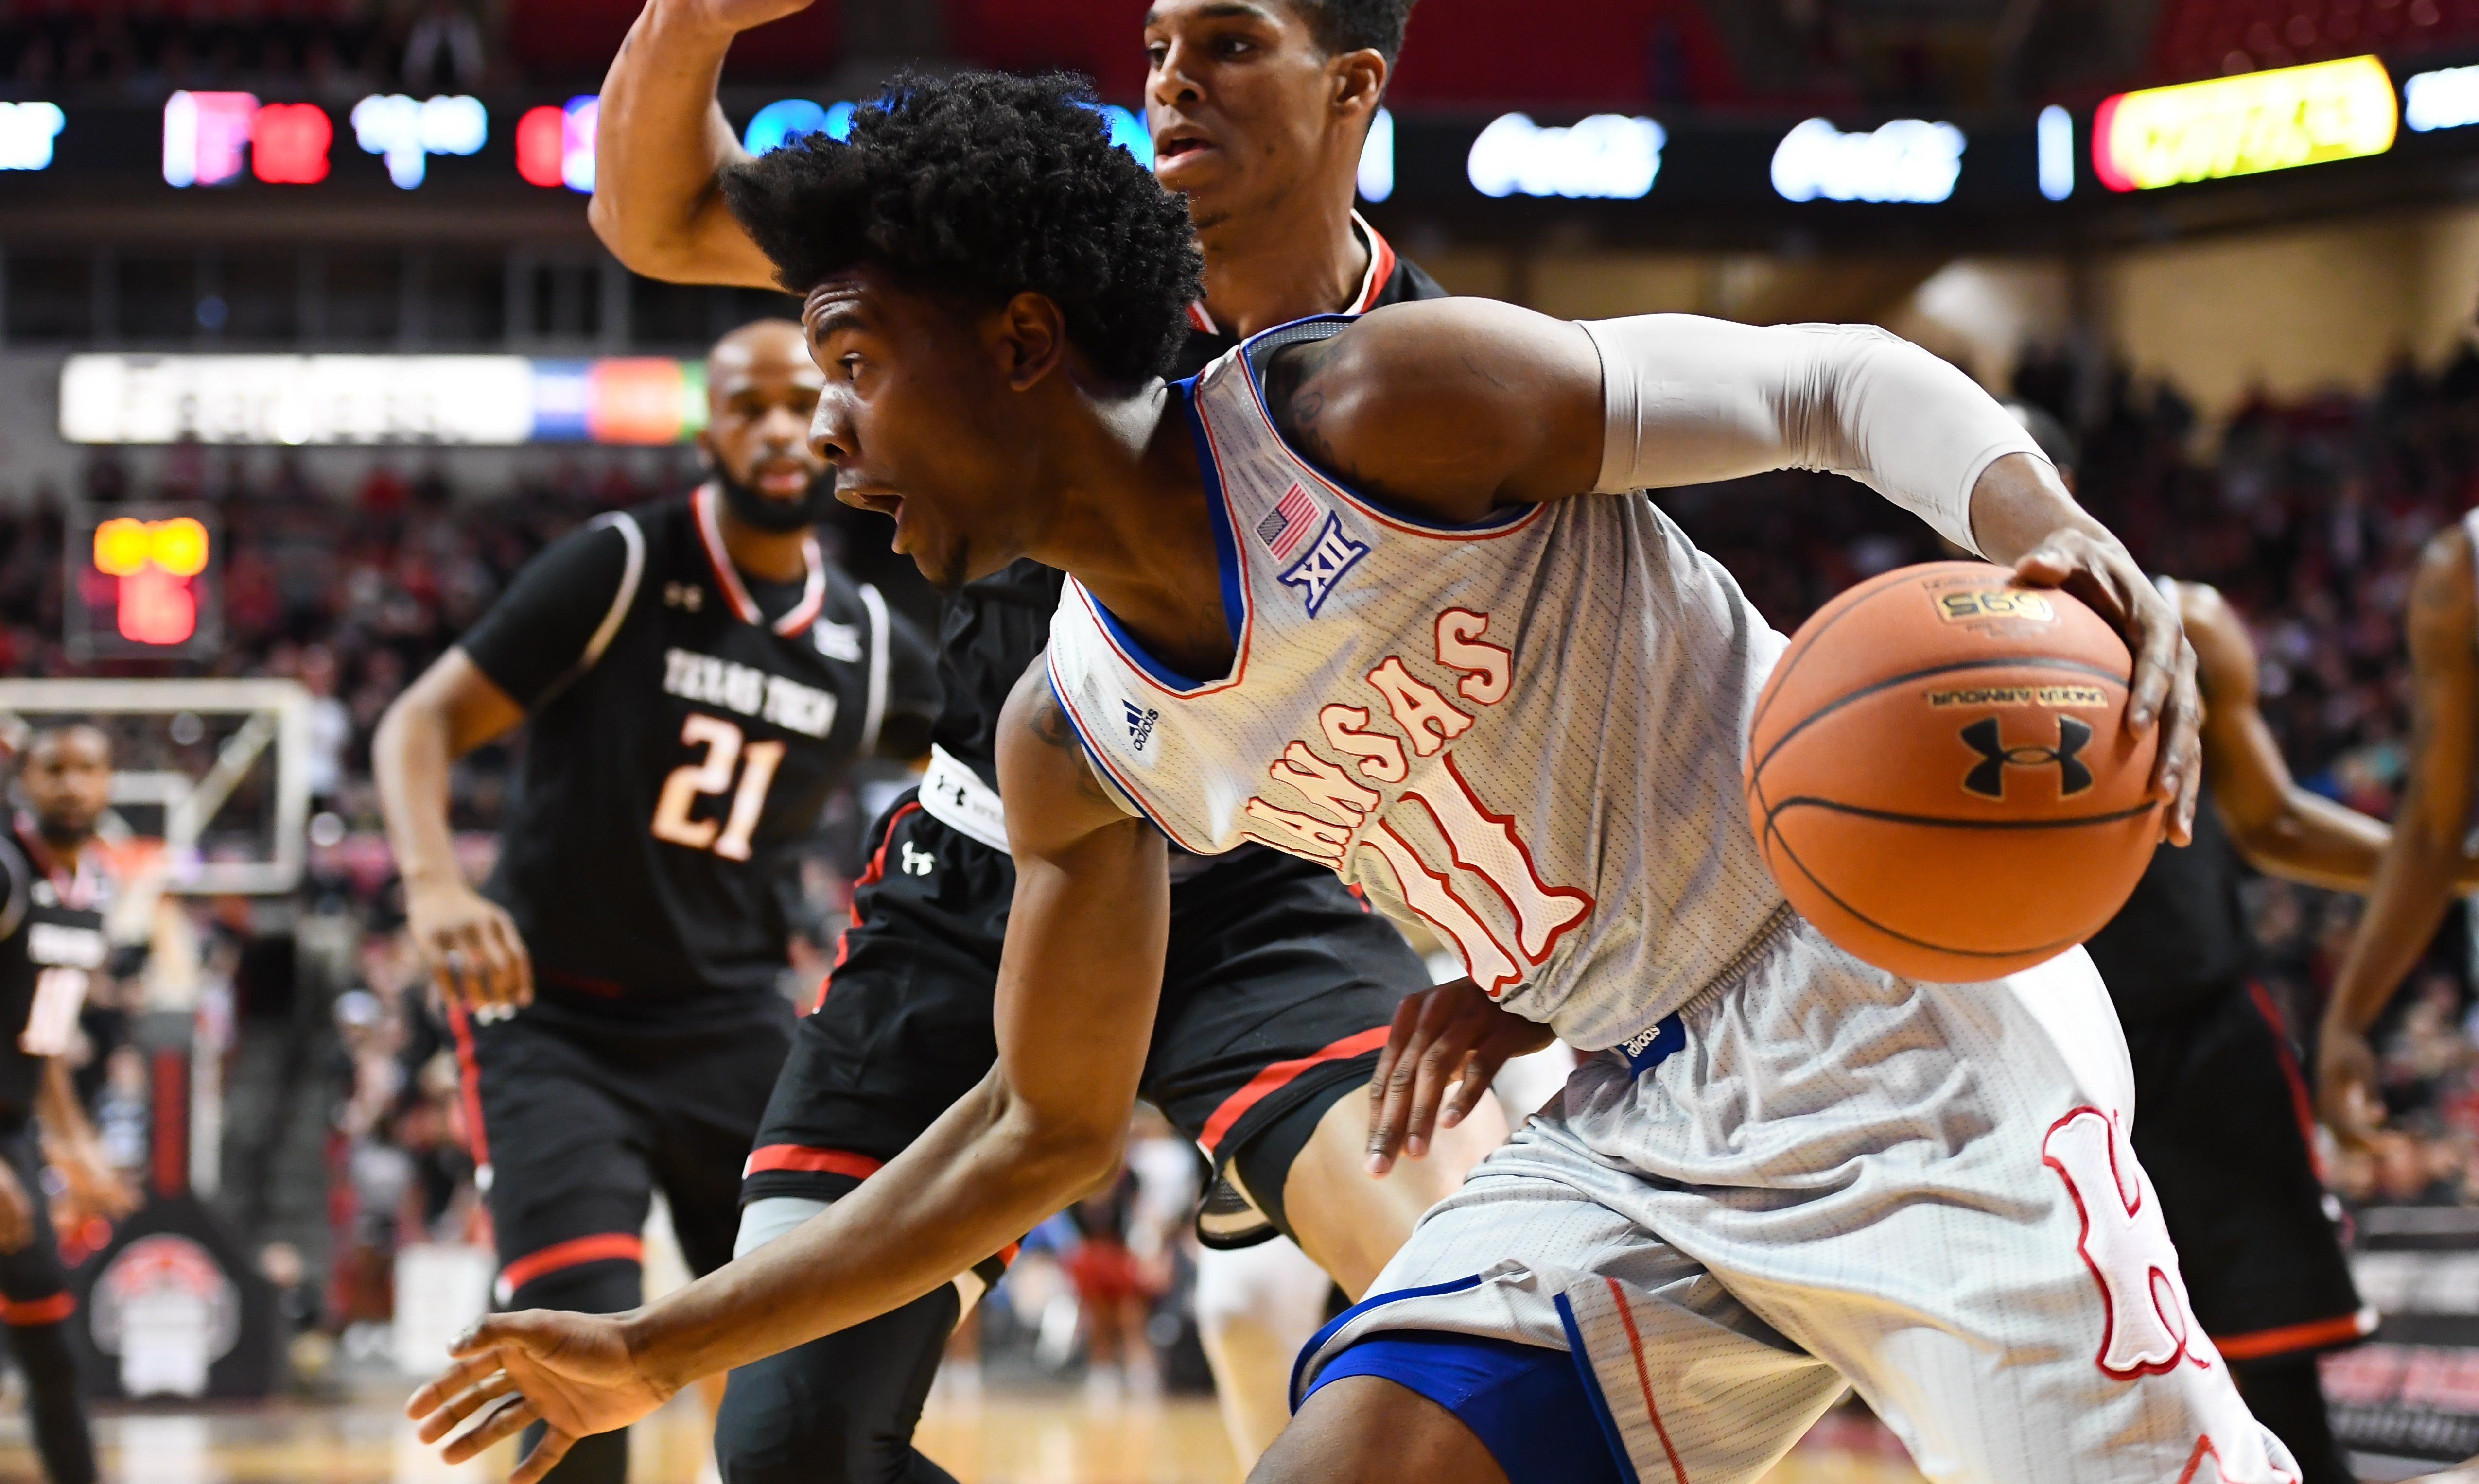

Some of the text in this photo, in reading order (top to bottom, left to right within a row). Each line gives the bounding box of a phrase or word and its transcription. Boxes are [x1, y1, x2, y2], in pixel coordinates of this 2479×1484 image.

[1282, 515, 1366, 612] XII
[650, 711, 786, 863] 21
[1133, 708, 1159, 751] adidas
[1240, 607, 1512, 872] ANSAS
[1359, 752, 1595, 998] 11
